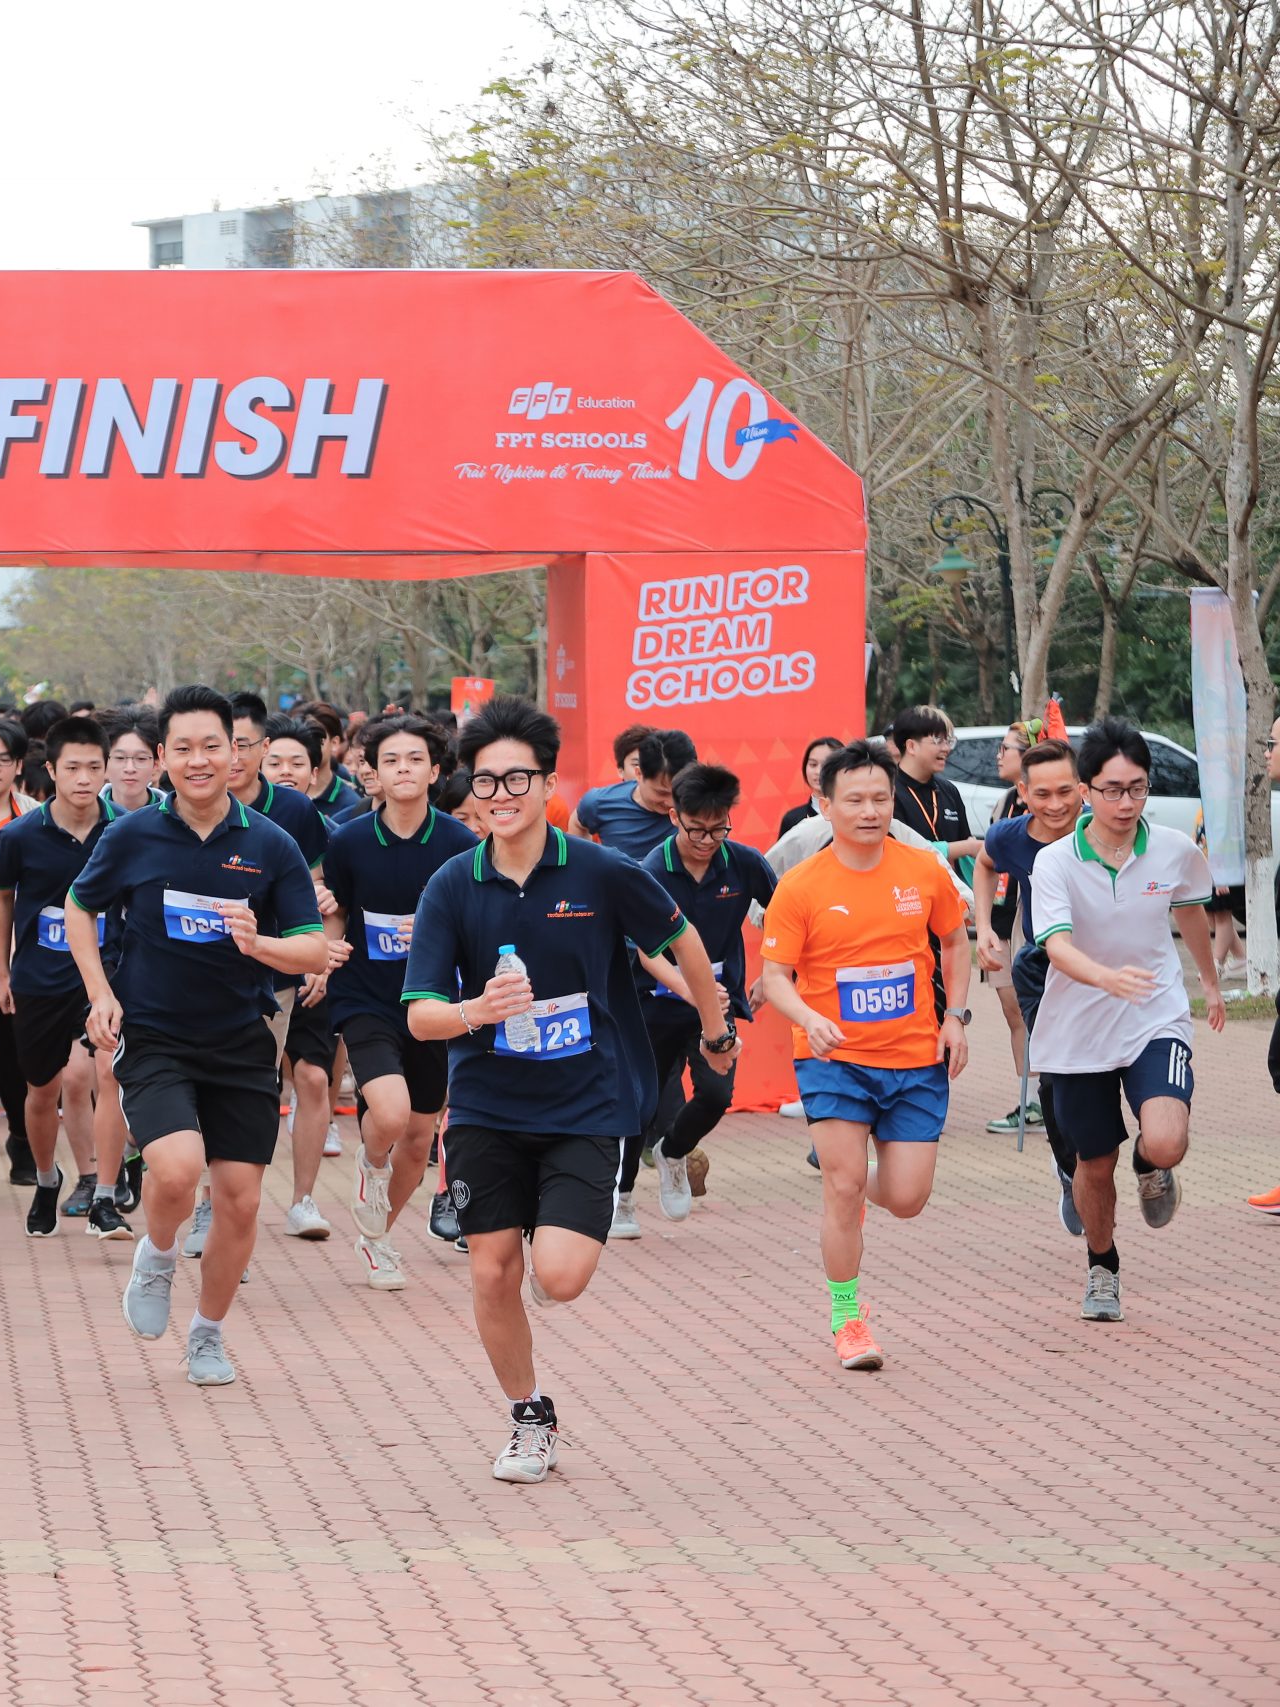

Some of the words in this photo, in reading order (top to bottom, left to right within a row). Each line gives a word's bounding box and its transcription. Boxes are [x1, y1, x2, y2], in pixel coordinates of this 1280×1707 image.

[508, 382, 572, 420] FPT
[577, 397, 635, 408] Education
[495, 433, 536, 448] FPT
[541, 433, 647, 448] SCHOOLS
[665, 377, 768, 481] 10
[490, 463, 547, 485] Nghiệm
[628, 461, 672, 480] Thành
[641, 577, 721, 619] RUN
[728, 568, 806, 608] FOR
[635, 616, 769, 663] DREAM
[628, 654, 813, 708] SCHOOLS
[852, 983, 908, 1013] 0595
[523, 1018, 581, 1053] 123
